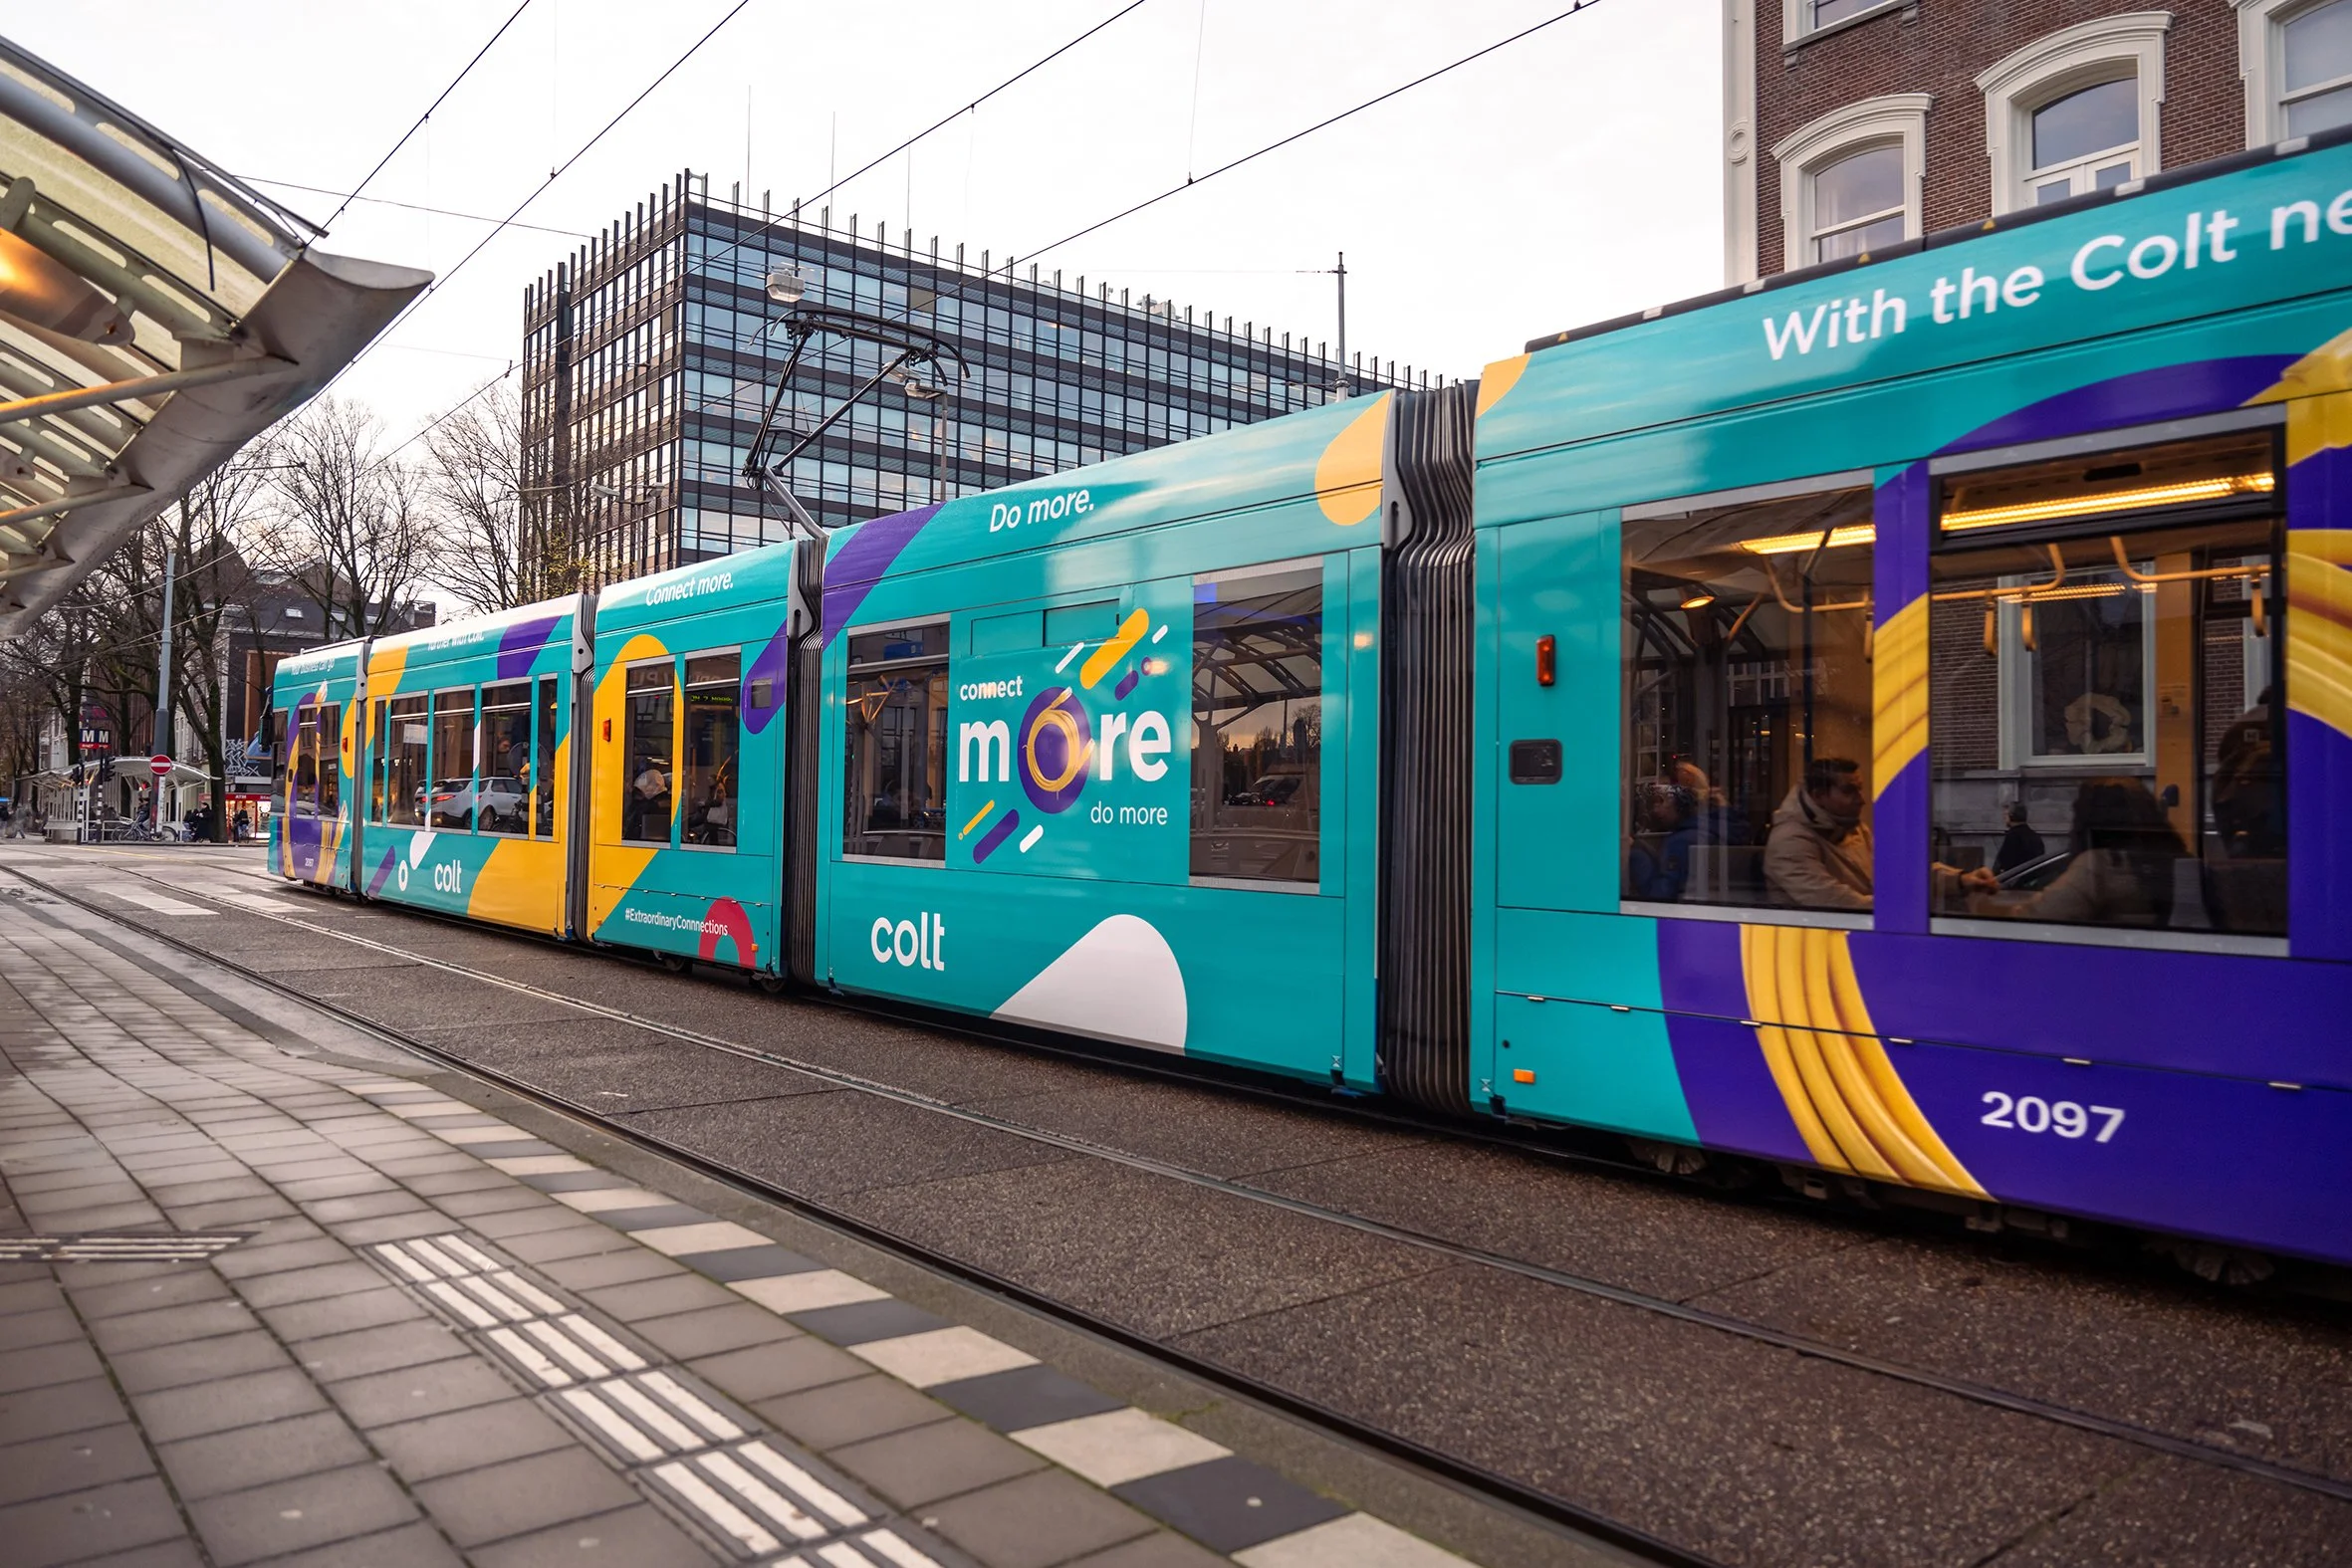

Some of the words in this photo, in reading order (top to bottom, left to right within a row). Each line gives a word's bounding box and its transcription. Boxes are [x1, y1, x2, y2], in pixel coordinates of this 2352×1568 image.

[1763, 290, 1906, 361] With
[1930, 266, 2045, 325] the
[2070, 210, 2238, 292] Colt
[989, 503, 1022, 533] Do
[1027, 489, 1094, 525] more.
[645, 576, 696, 606] Connect
[697, 571, 734, 596] more.
[959, 675, 1024, 701] connect
[82, 730, 95, 743] M
[99, 730, 110, 743] M
[958, 687, 1171, 794] more
[1090, 802, 1114, 825] do
[1120, 804, 1168, 826] more
[434, 859, 462, 893] colt
[871, 911, 945, 972] colt
[1980, 1091, 2126, 1144] 2097
